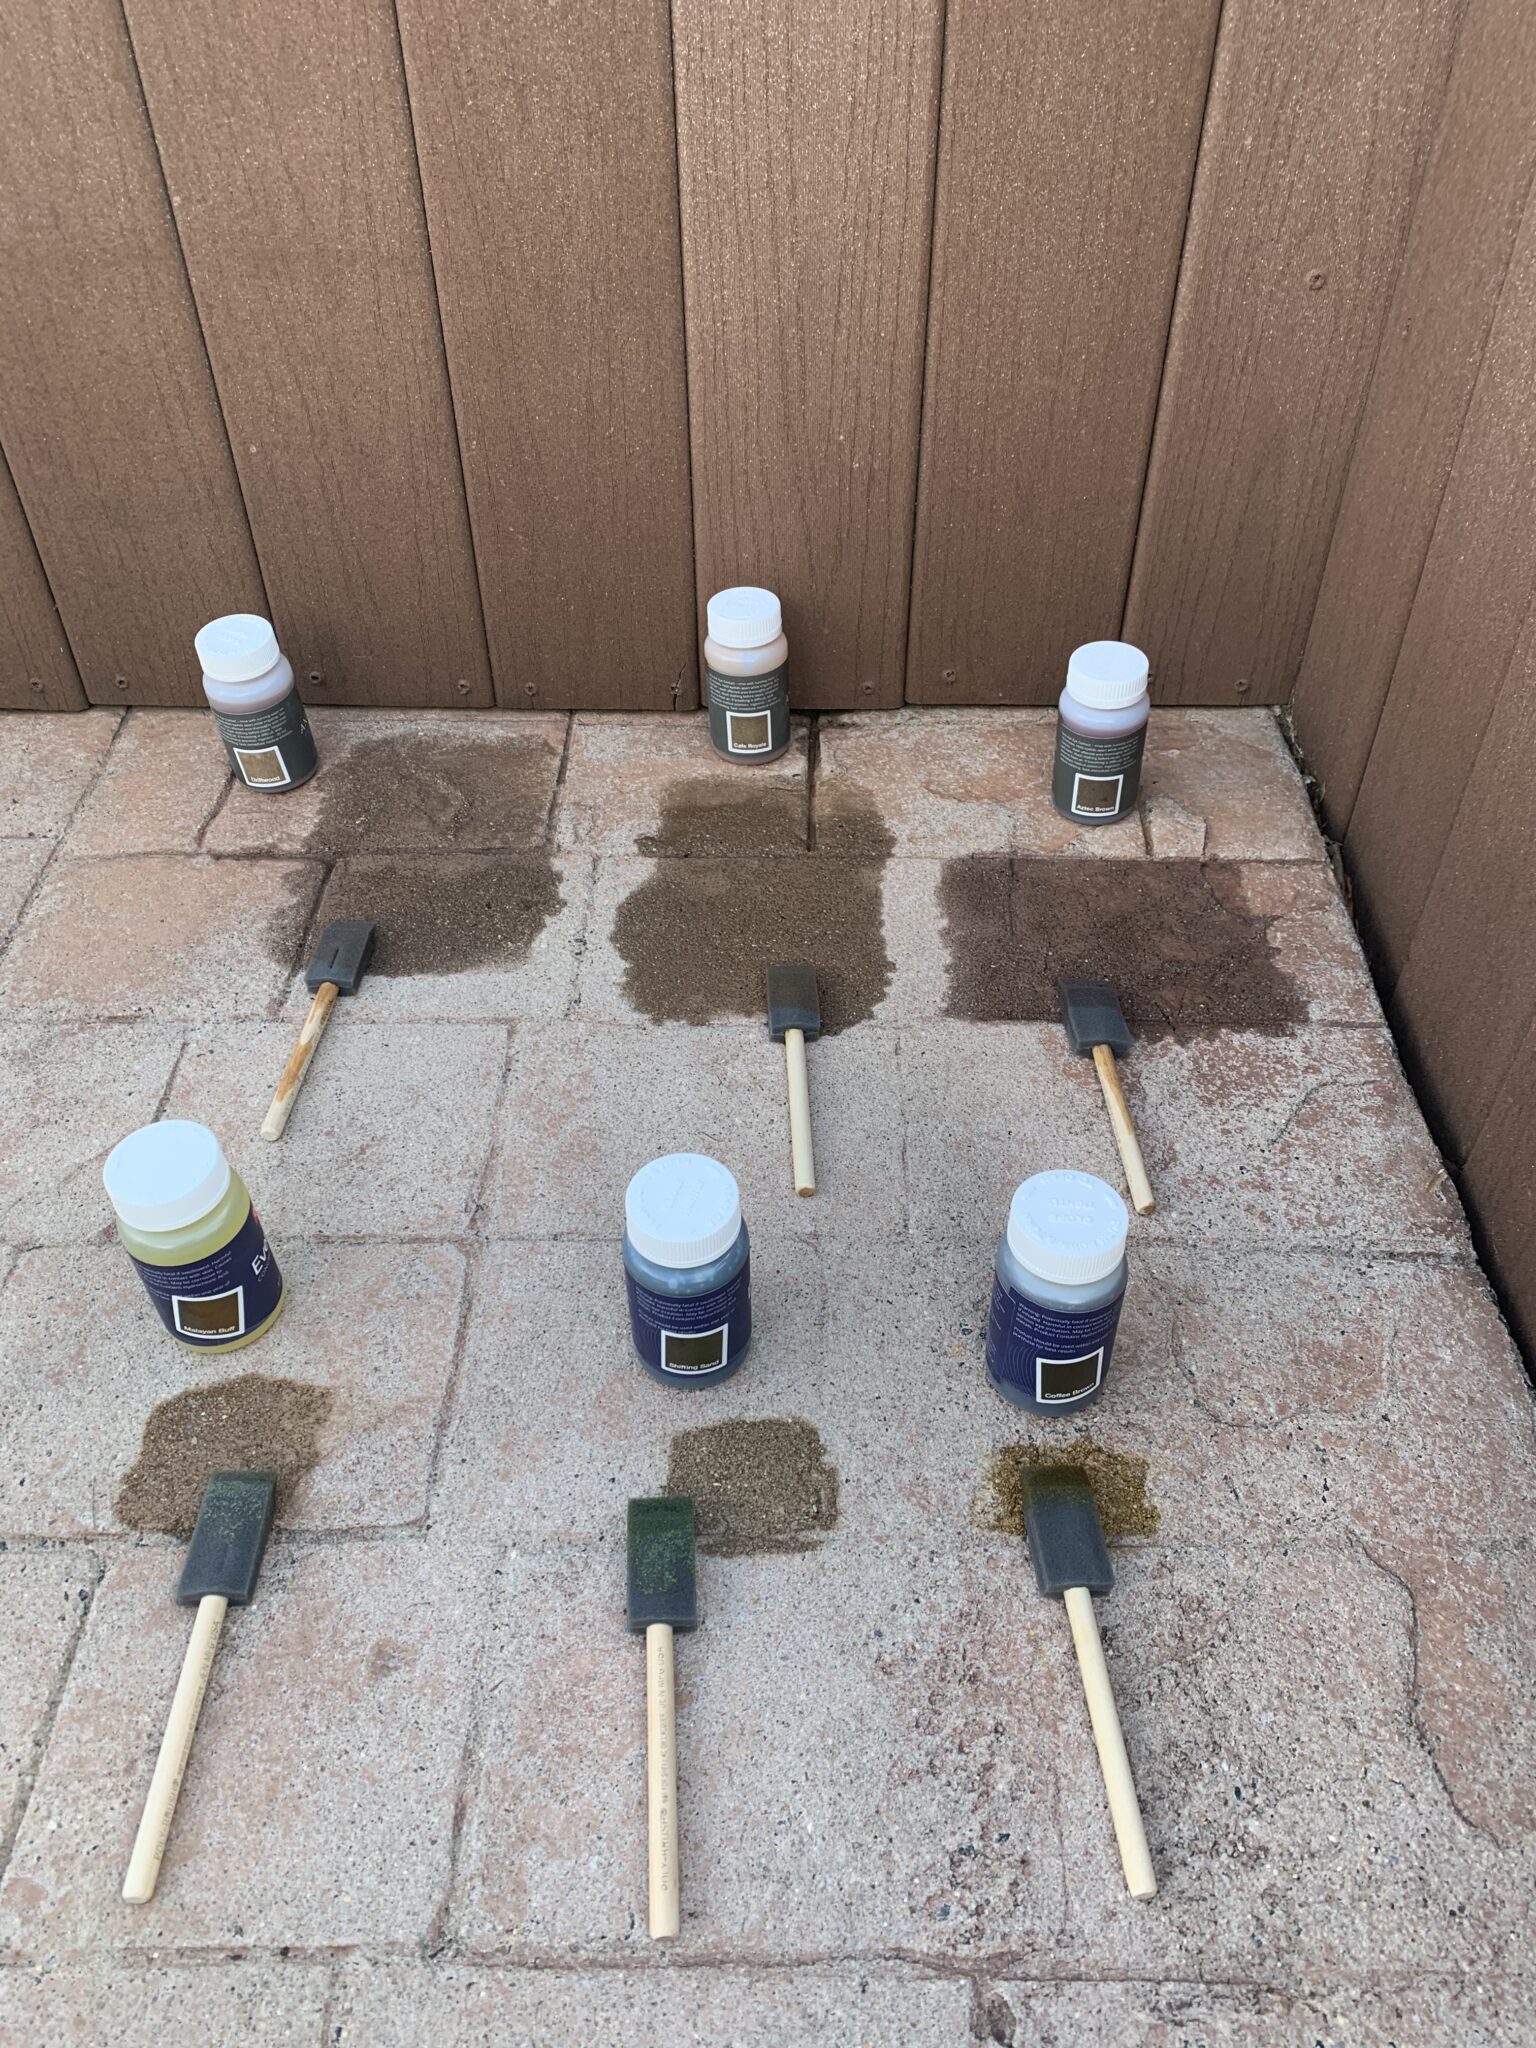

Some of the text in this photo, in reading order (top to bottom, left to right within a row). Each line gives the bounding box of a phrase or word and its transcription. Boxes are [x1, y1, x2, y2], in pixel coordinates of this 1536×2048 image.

[1076, 804, 1094, 812] Aztec
[219, 1325, 236, 1334] Buff
[700, 1359, 720, 1369] Sand
[1072, 1382, 1095, 1396] Brown
